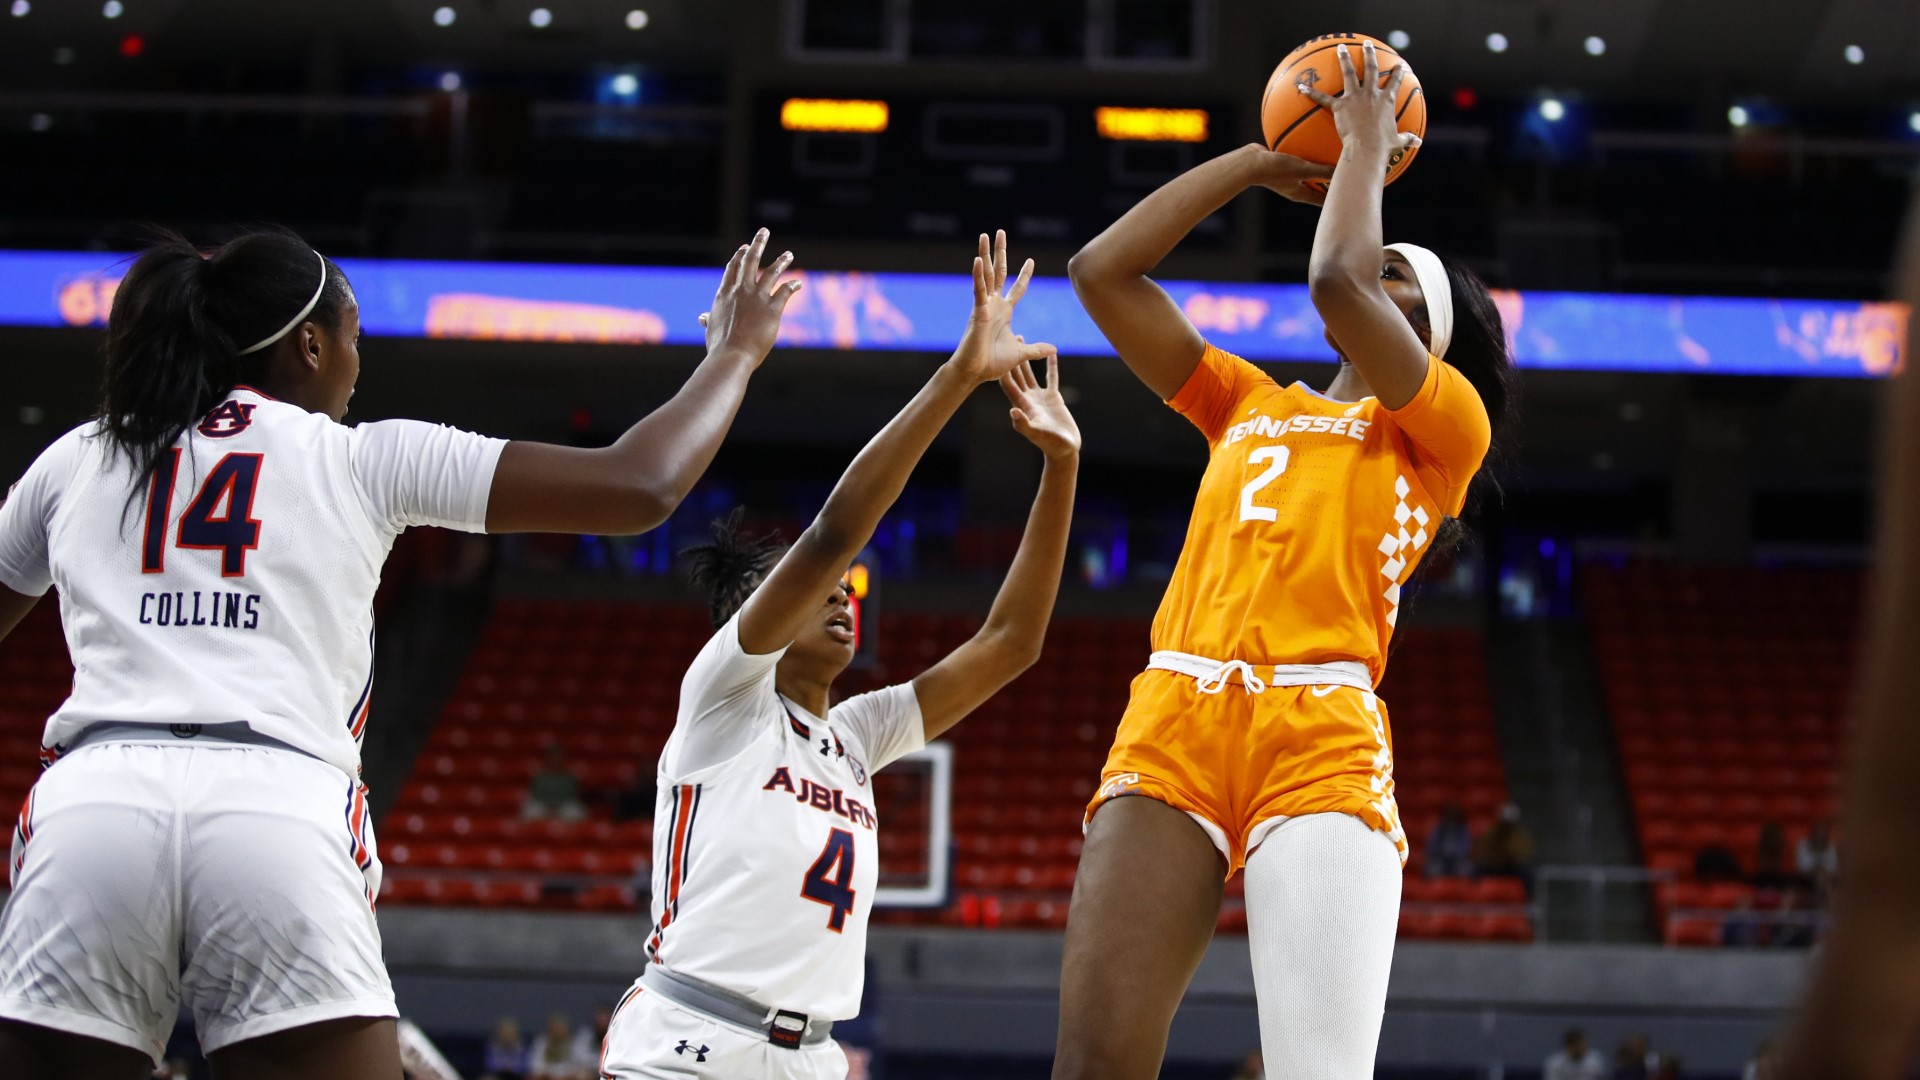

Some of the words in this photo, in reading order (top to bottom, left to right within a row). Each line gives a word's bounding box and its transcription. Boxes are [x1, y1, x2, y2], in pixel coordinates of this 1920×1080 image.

[1224, 415, 1372, 448] TENNESSEE
[142, 447, 264, 578] 14
[1239, 445, 1290, 523] 2
[139, 591, 260, 630] COLLINS
[800, 827, 856, 934] 4
